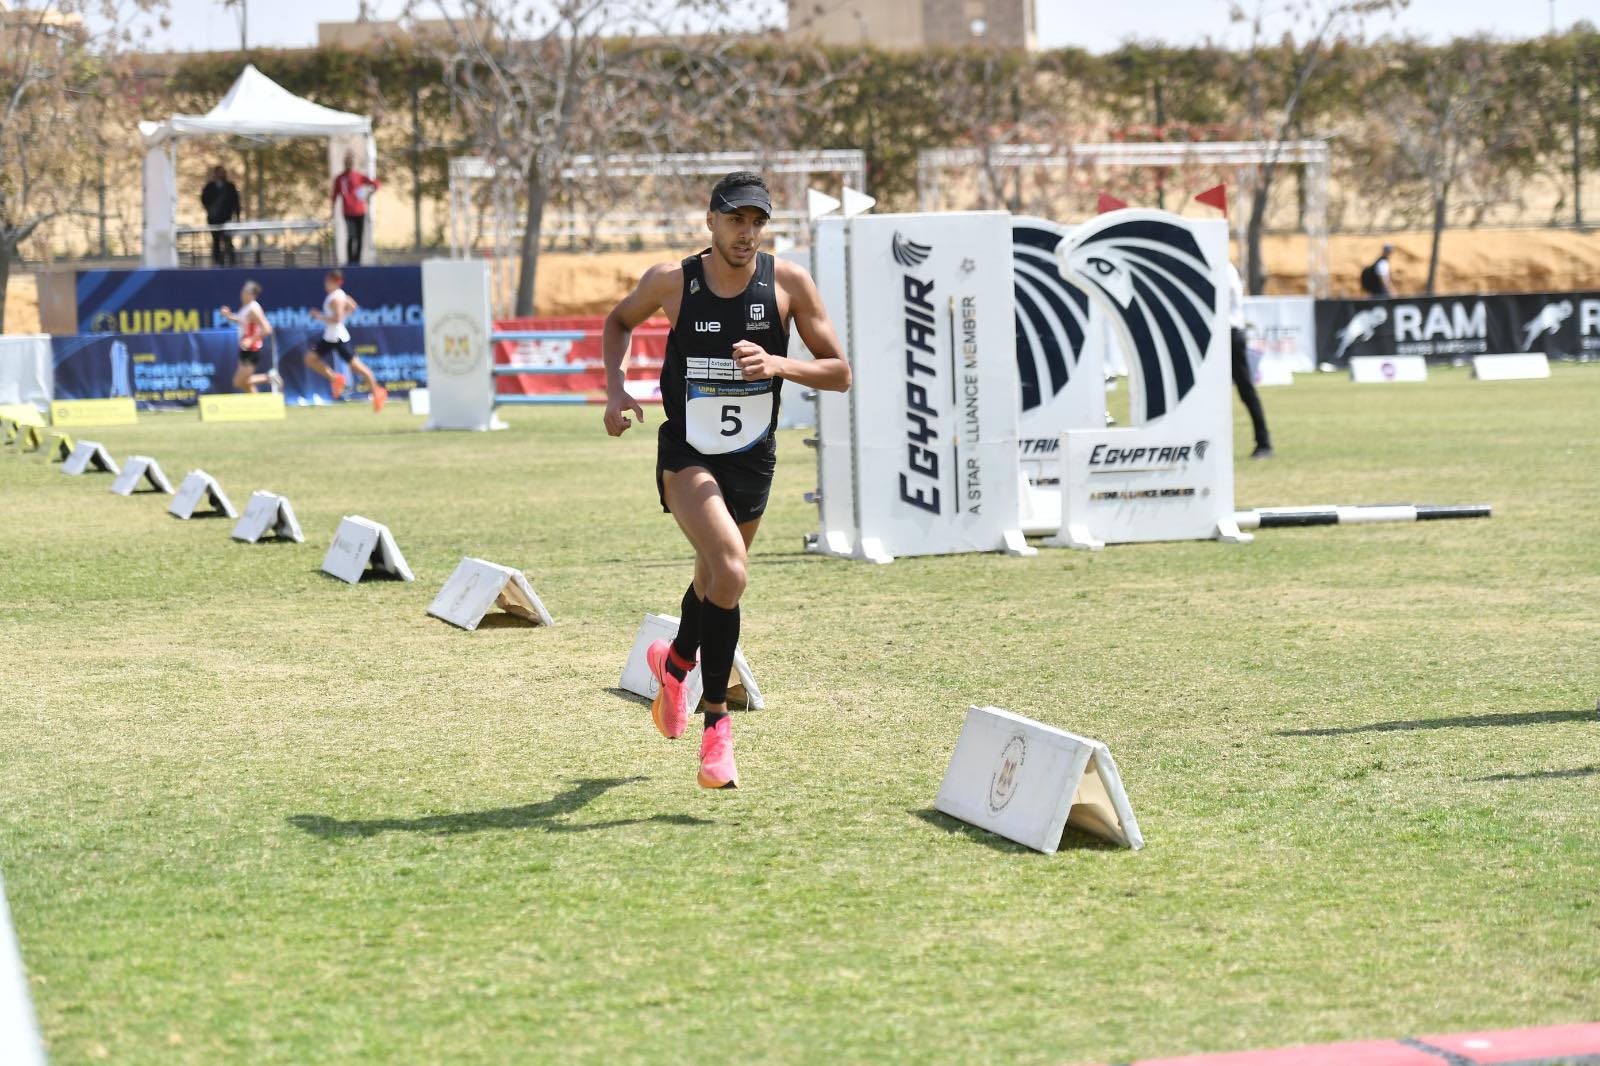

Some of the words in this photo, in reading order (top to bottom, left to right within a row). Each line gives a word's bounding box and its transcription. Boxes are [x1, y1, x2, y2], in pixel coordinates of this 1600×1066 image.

[119, 309, 200, 333] UIPM
[961, 295, 977, 369] MEMBER
[1393, 301, 1487, 342] RAM
[899, 274, 941, 516] EGYPTAIR
[965, 374, 980, 444] LLIANCE
[720, 404, 743, 437] 5
[1088, 443, 1192, 466] EGYPTAIR
[968, 457, 982, 502] STAR
